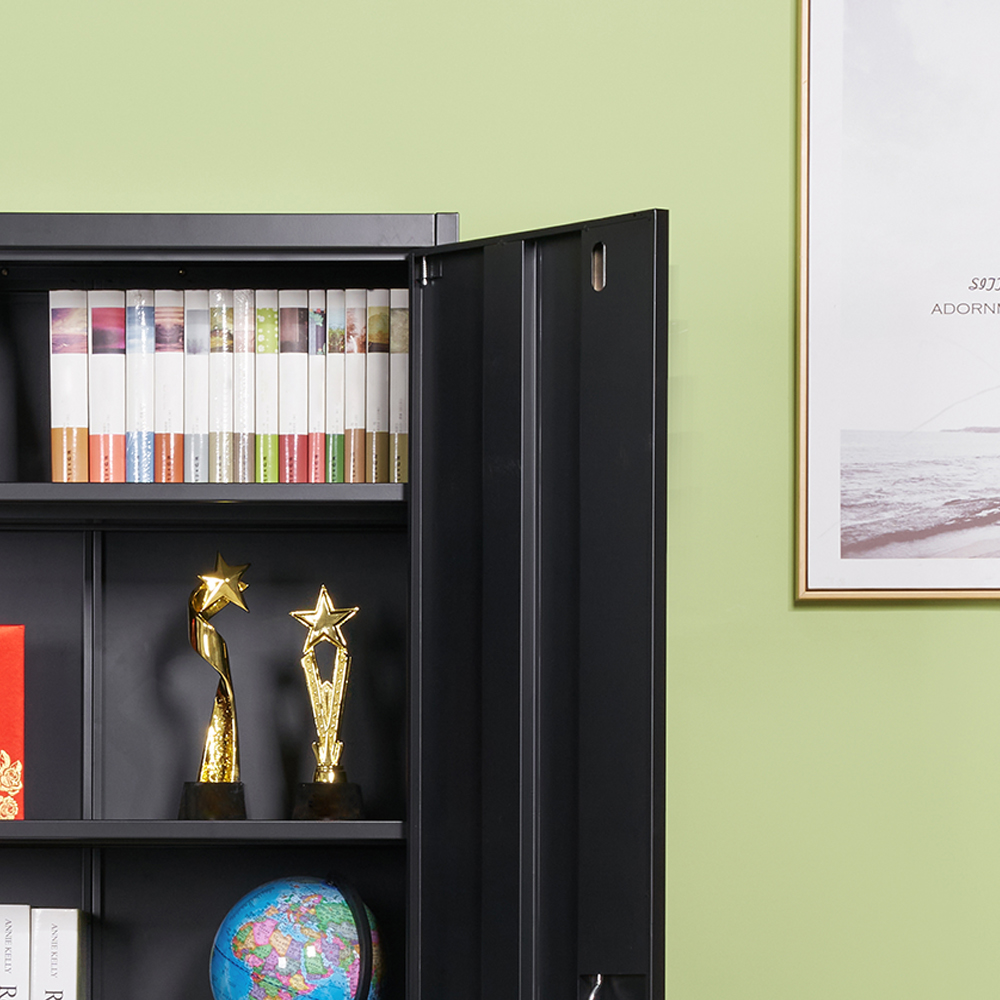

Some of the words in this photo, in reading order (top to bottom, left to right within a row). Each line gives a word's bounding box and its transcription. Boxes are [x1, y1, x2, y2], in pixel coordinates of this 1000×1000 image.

[930, 303, 1000, 315] ADORN
[4, 946, 12, 974] KELLY
[50, 951, 58, 979] KELLY
